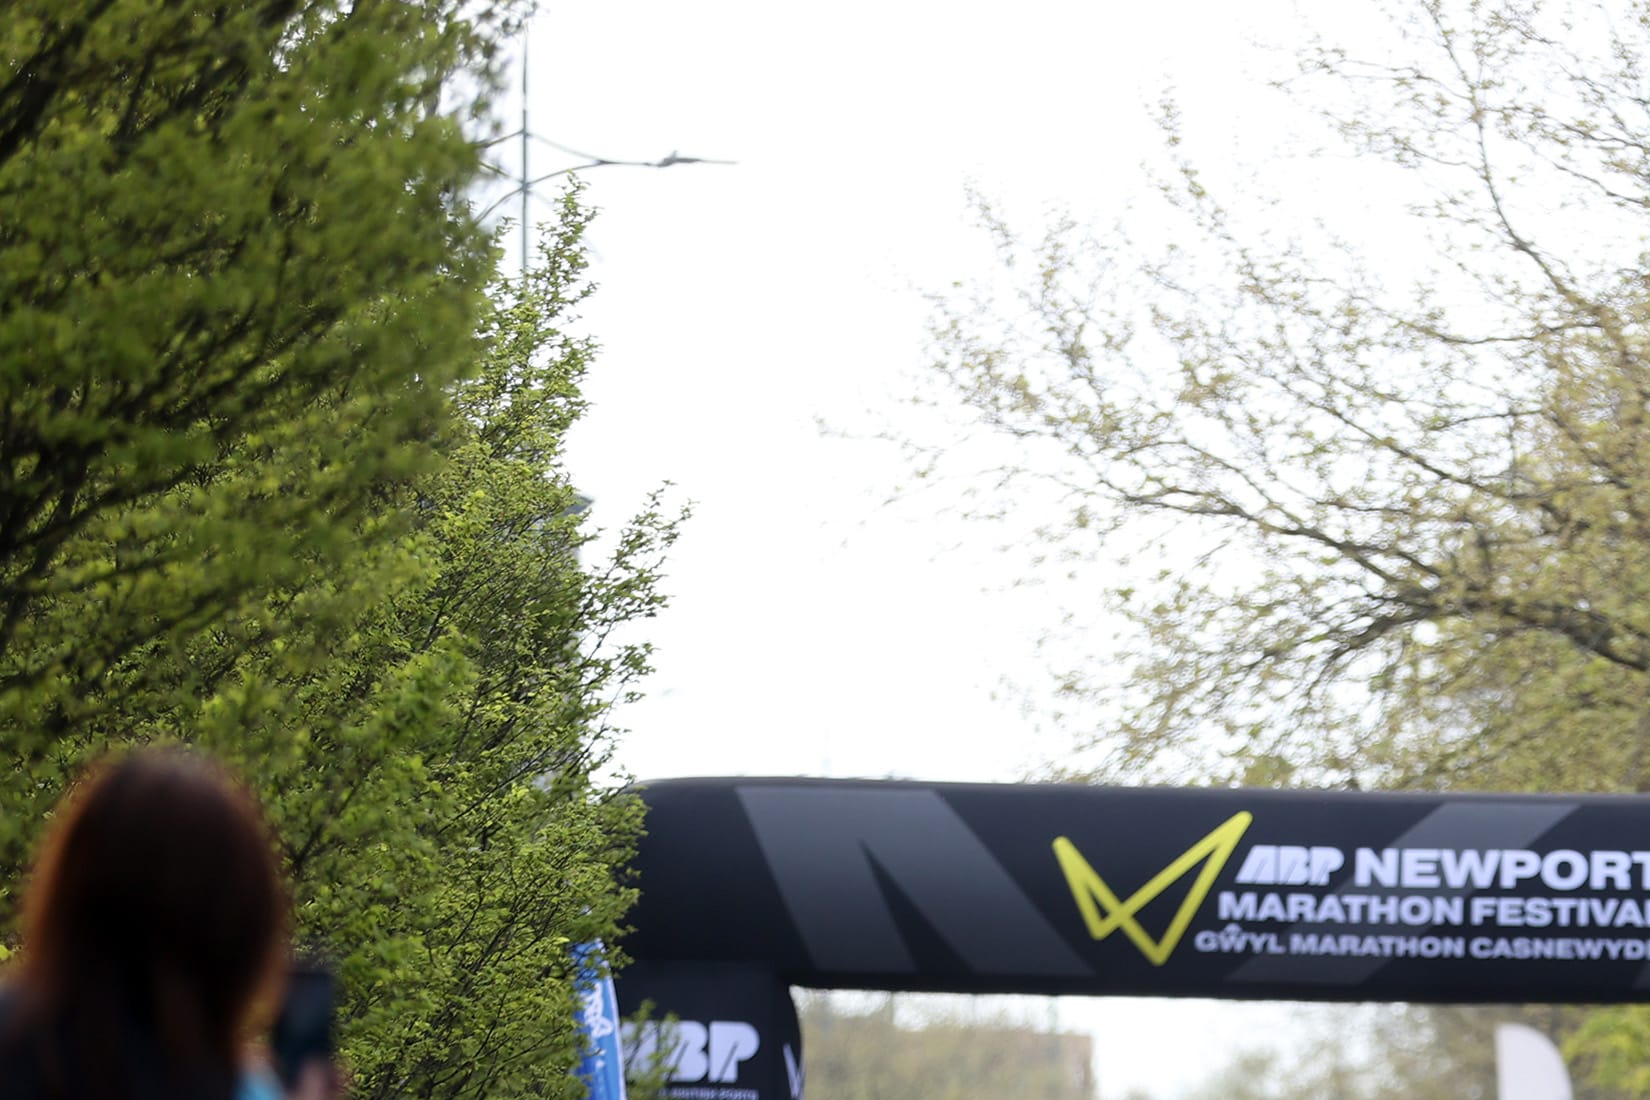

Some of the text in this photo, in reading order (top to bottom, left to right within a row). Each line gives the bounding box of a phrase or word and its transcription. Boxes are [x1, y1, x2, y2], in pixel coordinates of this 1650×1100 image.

[1235, 845, 1344, 885] ABP
[1218, 891, 1465, 926] MARATHON
[1289, 933, 1466, 959] MARATHON
